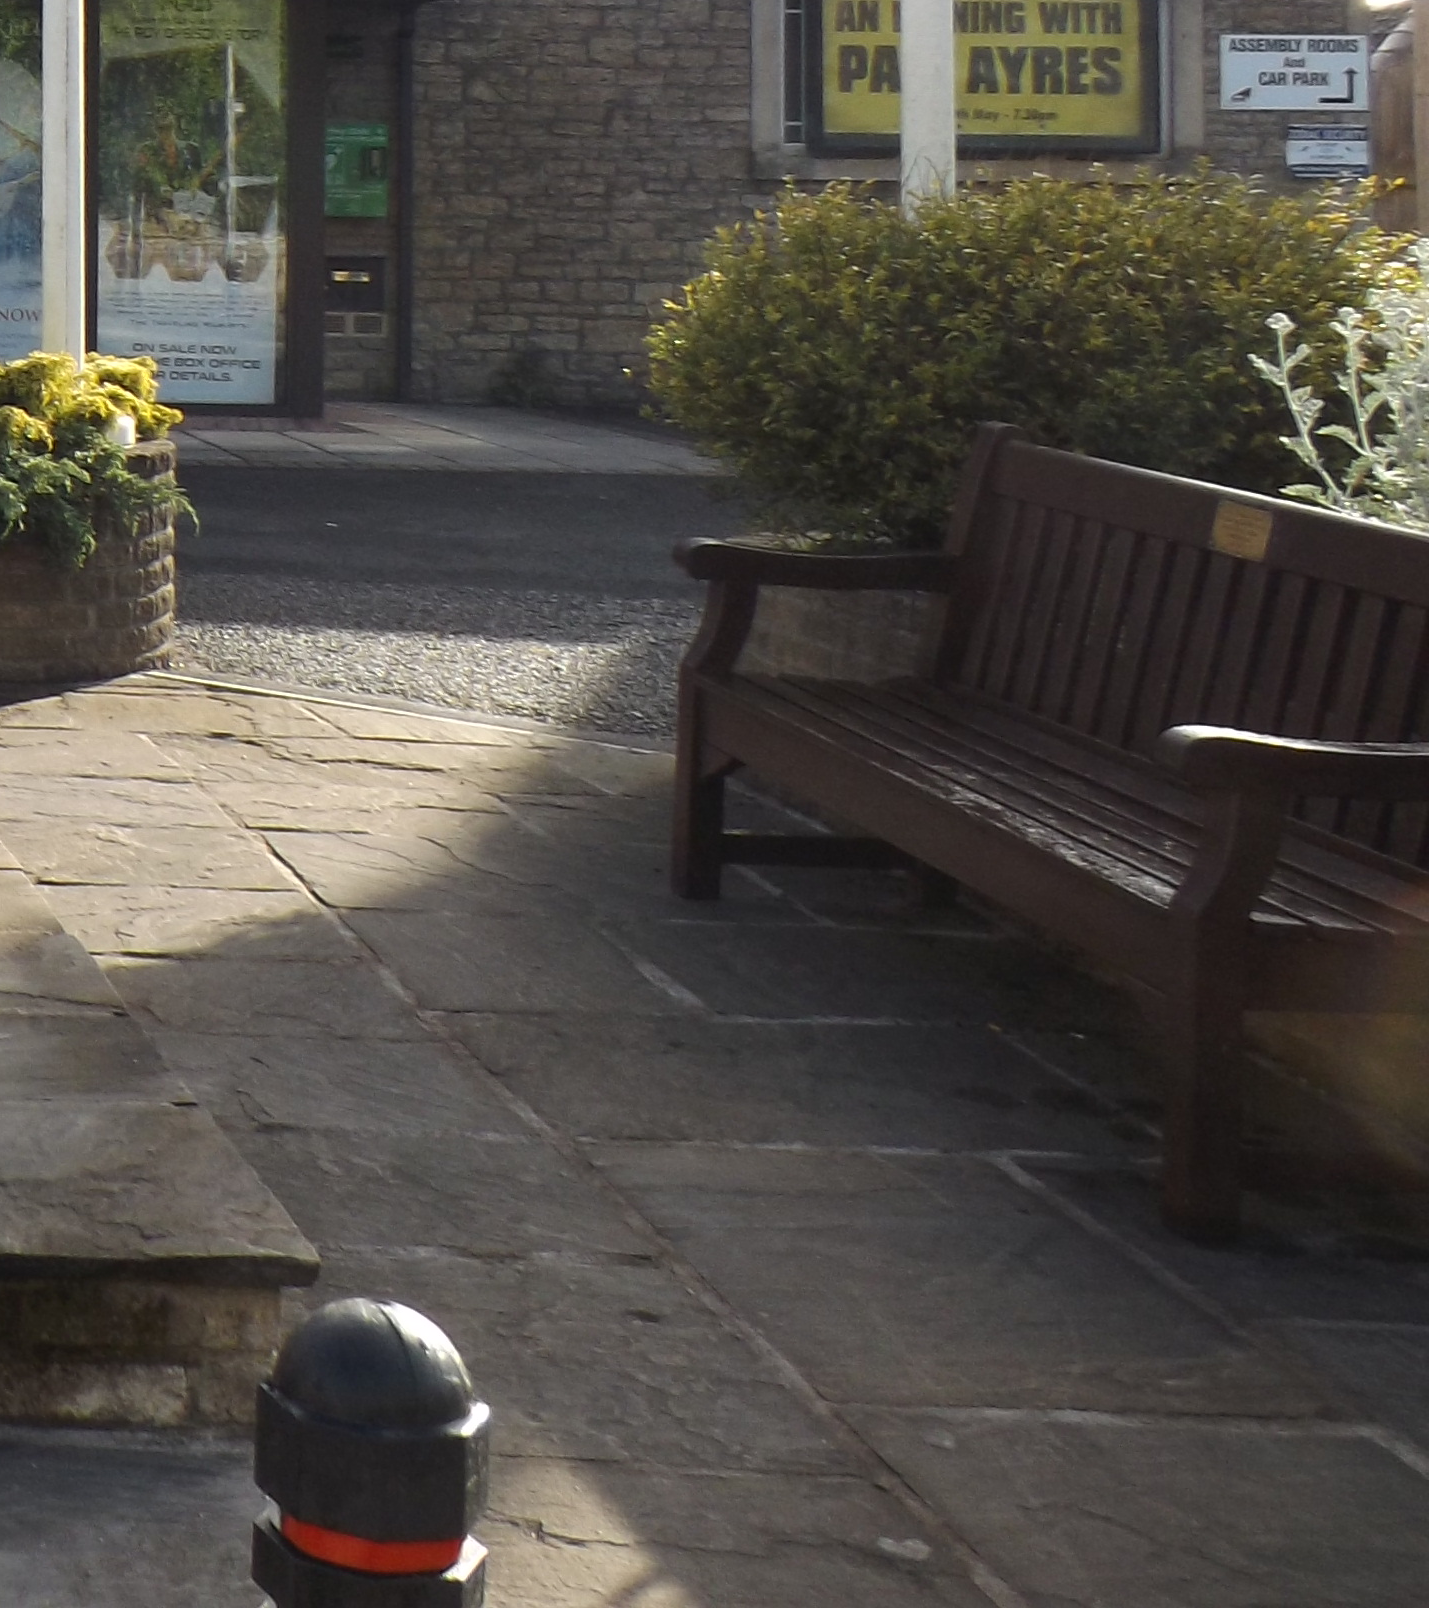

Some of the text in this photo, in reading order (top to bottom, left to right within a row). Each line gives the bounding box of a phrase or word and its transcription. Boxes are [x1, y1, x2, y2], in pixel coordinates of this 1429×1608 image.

[834, 0, 880, 33] AN
[1038, 1, 1122, 34] WITH
[1228, 38, 1359, 53] ASSEMBLY ROOMS
[1282, 56, 1306, 68] And
[838, 44, 1123, 95] PA AYRES
[1258, 72, 1330, 86] CAR PARK
[132, 342, 237, 355] ON SALE NOW
[174, 357, 206, 368] BOX
[209, 359, 261, 370] OFFICE
[169, 371, 234, 382] DETAILS.
